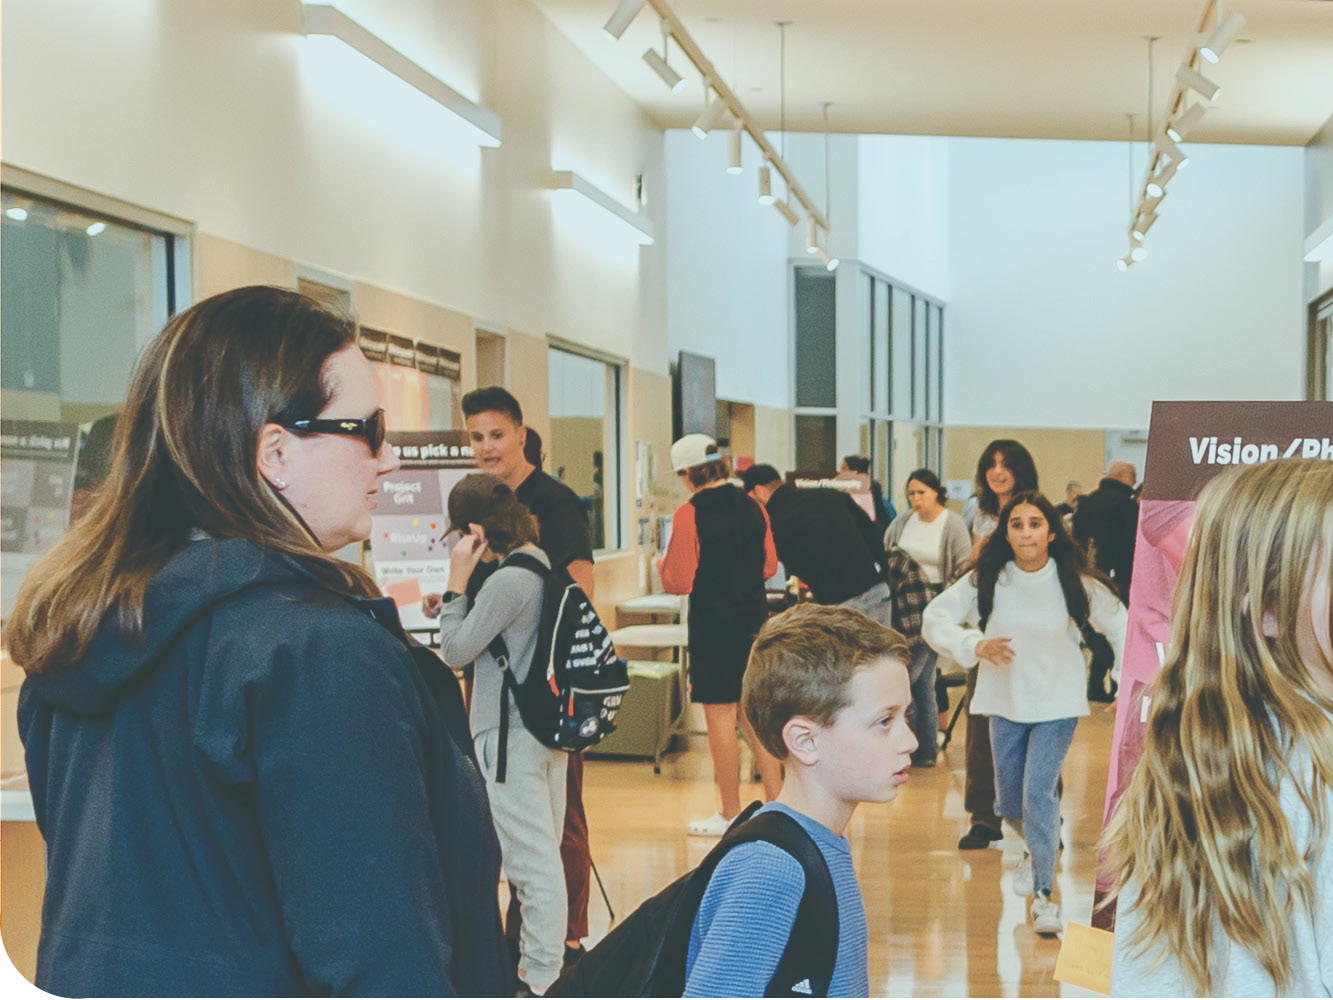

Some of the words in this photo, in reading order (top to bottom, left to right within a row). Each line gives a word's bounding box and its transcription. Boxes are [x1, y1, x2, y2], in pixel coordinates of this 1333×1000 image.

[403, 445, 419, 457] us
[420, 443, 448, 460] pick
[450, 445, 459, 457] a
[383, 481, 421, 495] Project
